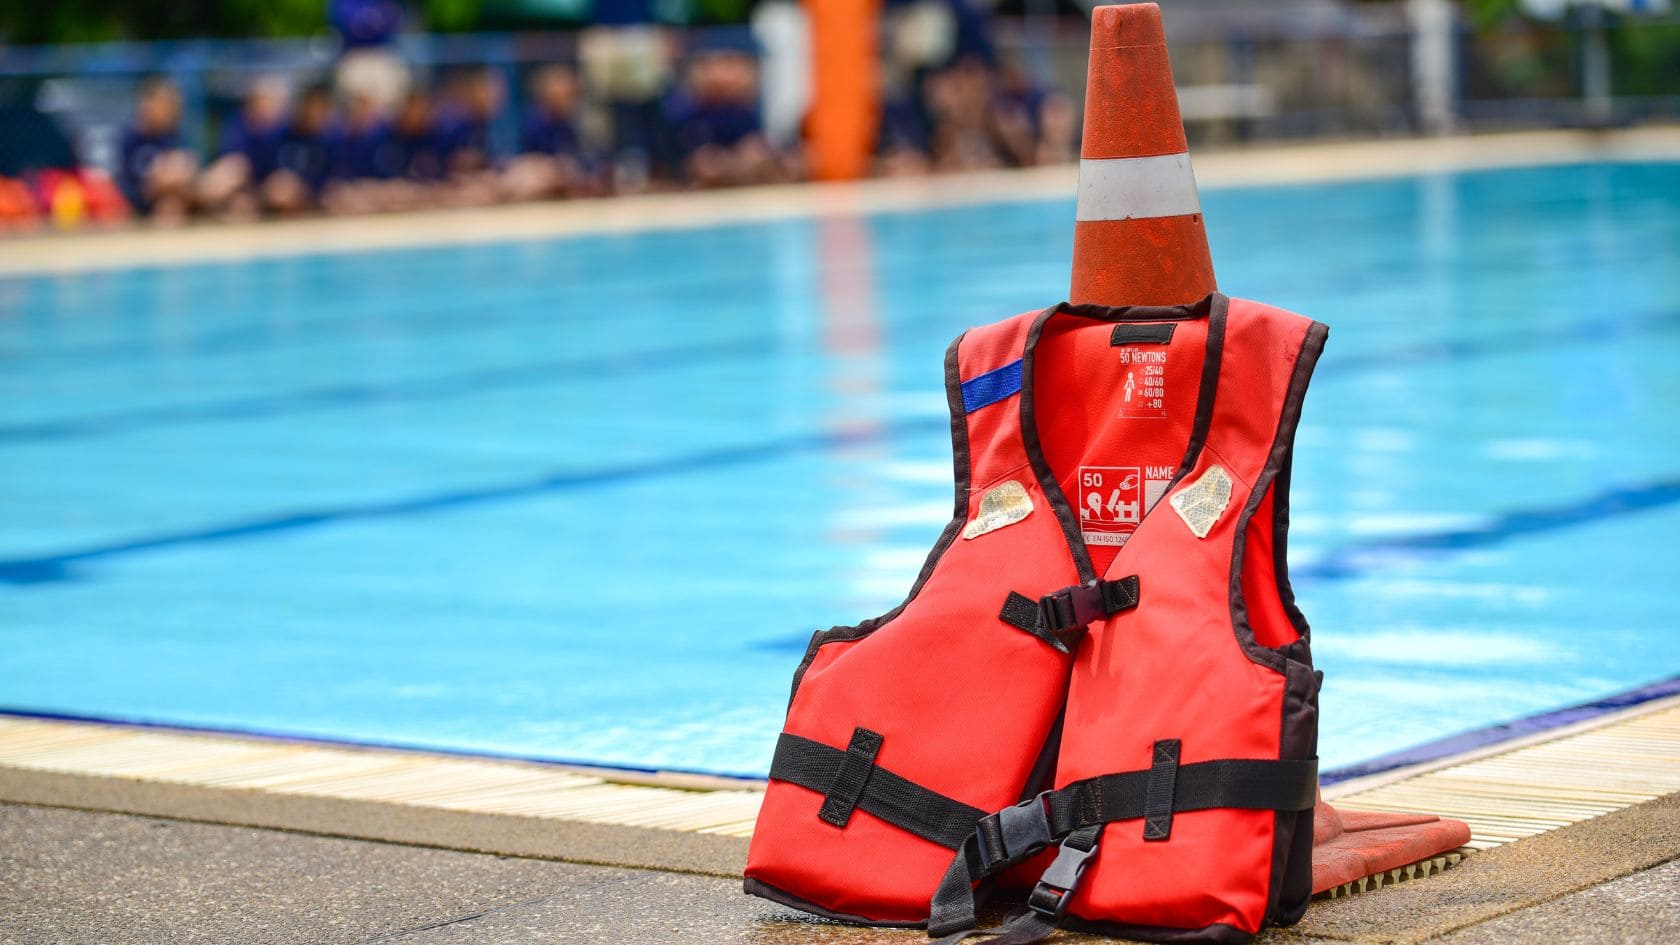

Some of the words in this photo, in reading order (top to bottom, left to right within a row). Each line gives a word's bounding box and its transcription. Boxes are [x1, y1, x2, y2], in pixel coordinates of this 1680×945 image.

[1120, 352, 1130, 364] 50
[1131, 351, 1167, 363] NEWTONS
[1145, 365, 1164, 376] 25/40
[1144, 377, 1164, 387] 40/60
[1144, 387, 1164, 398] 60/80
[1146, 398, 1162, 409] +80
[1083, 472, 1103, 487] 50
[1145, 466, 1174, 480] NAME
[1103, 535, 1114, 543] ISO
